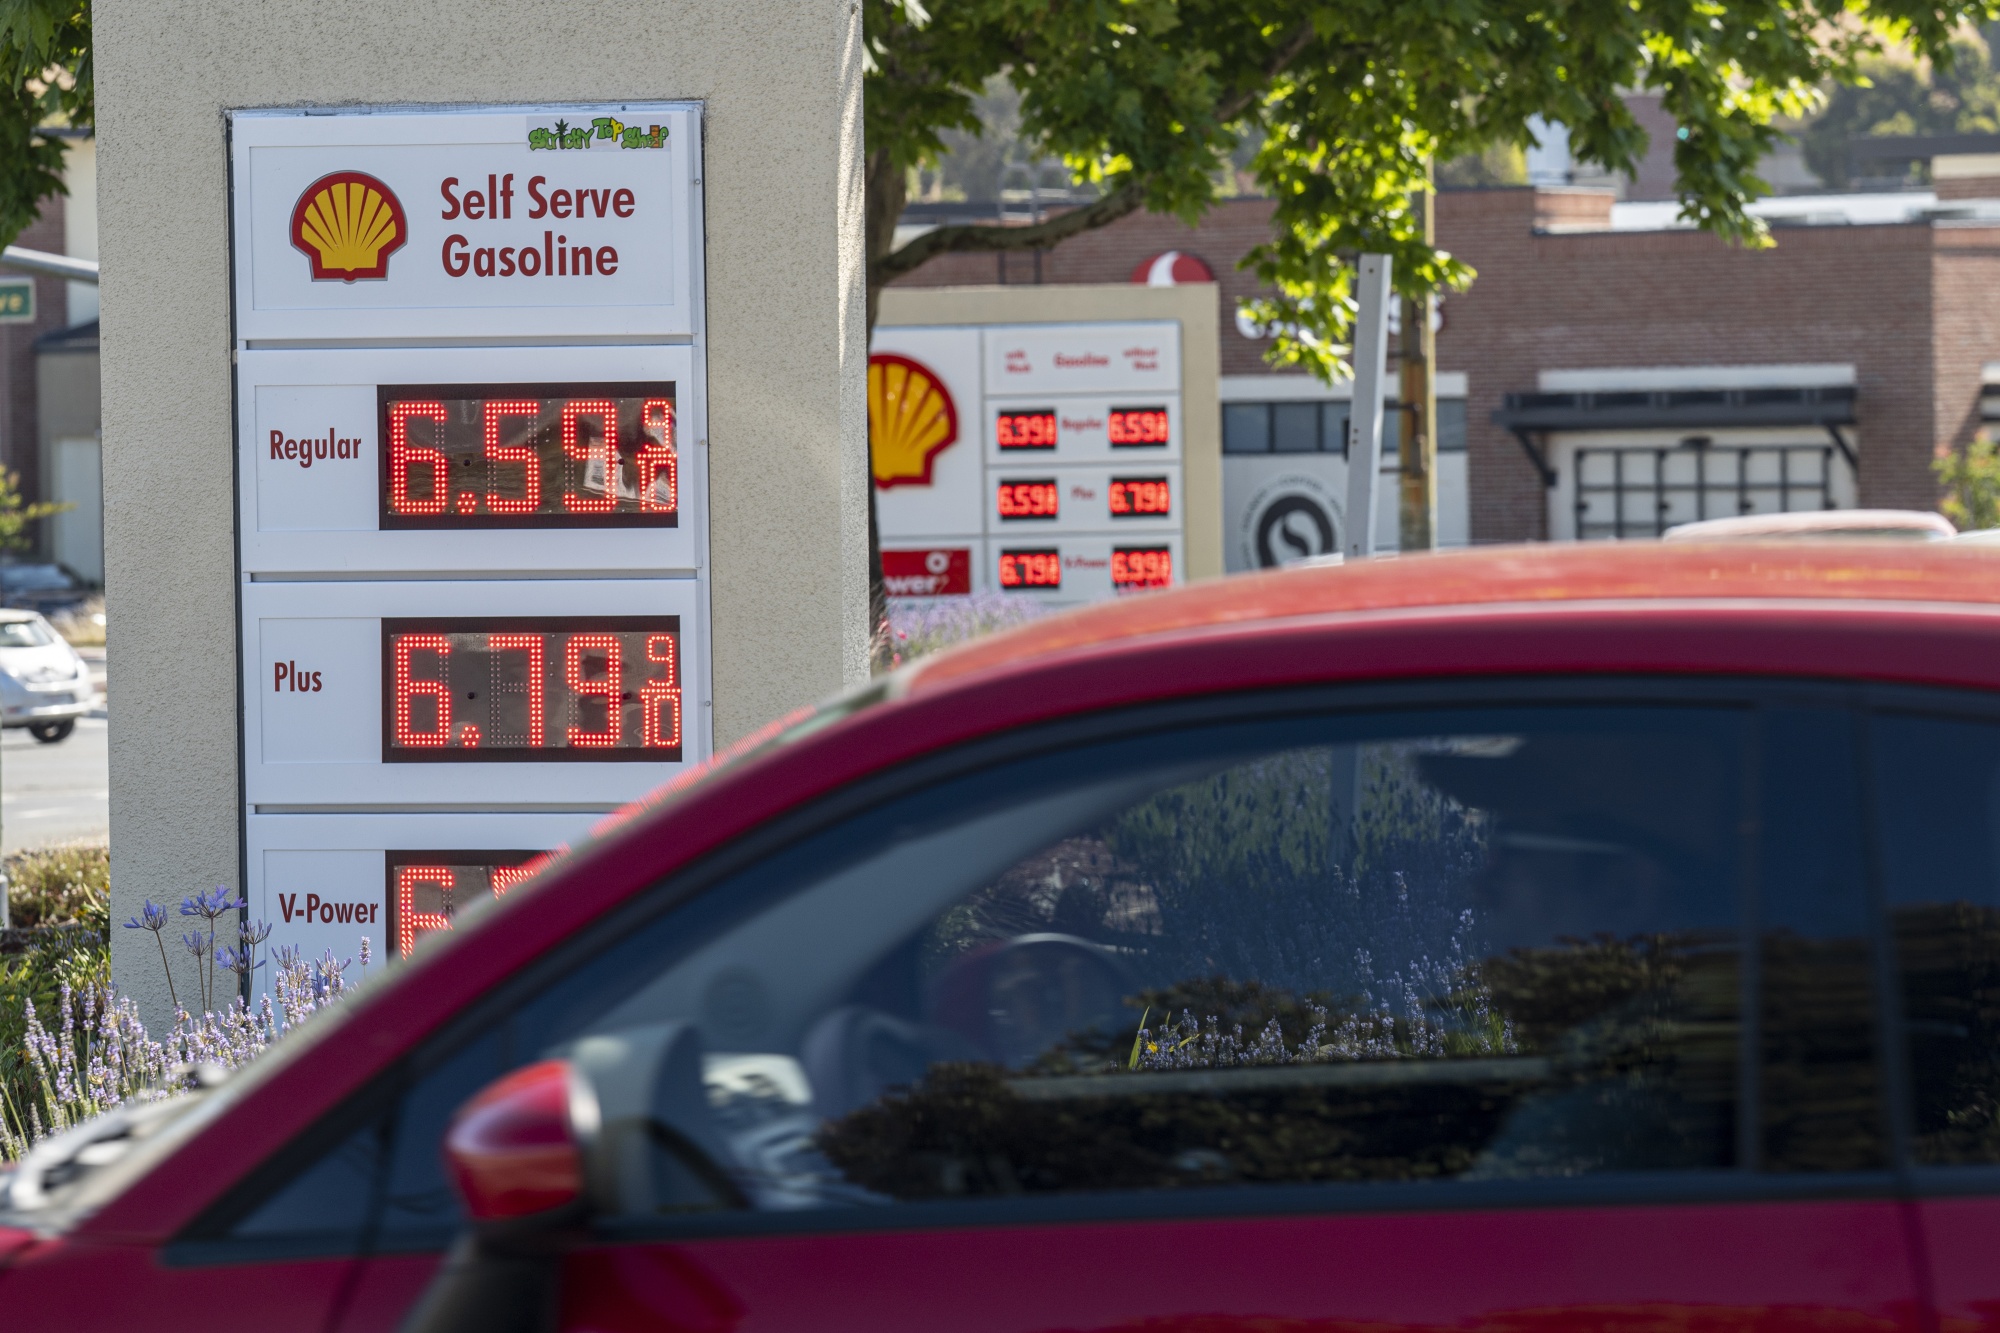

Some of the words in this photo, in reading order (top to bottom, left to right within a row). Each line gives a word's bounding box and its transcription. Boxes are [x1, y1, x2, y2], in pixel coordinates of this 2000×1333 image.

[441, 174, 513, 220] Self
[528, 175, 635, 219] Serve
[441, 231, 619, 278] Gasoline
[271, 428, 361, 468] Regular
[274, 660, 322, 692] Plus
[280, 893, 378, 924] V-Power
